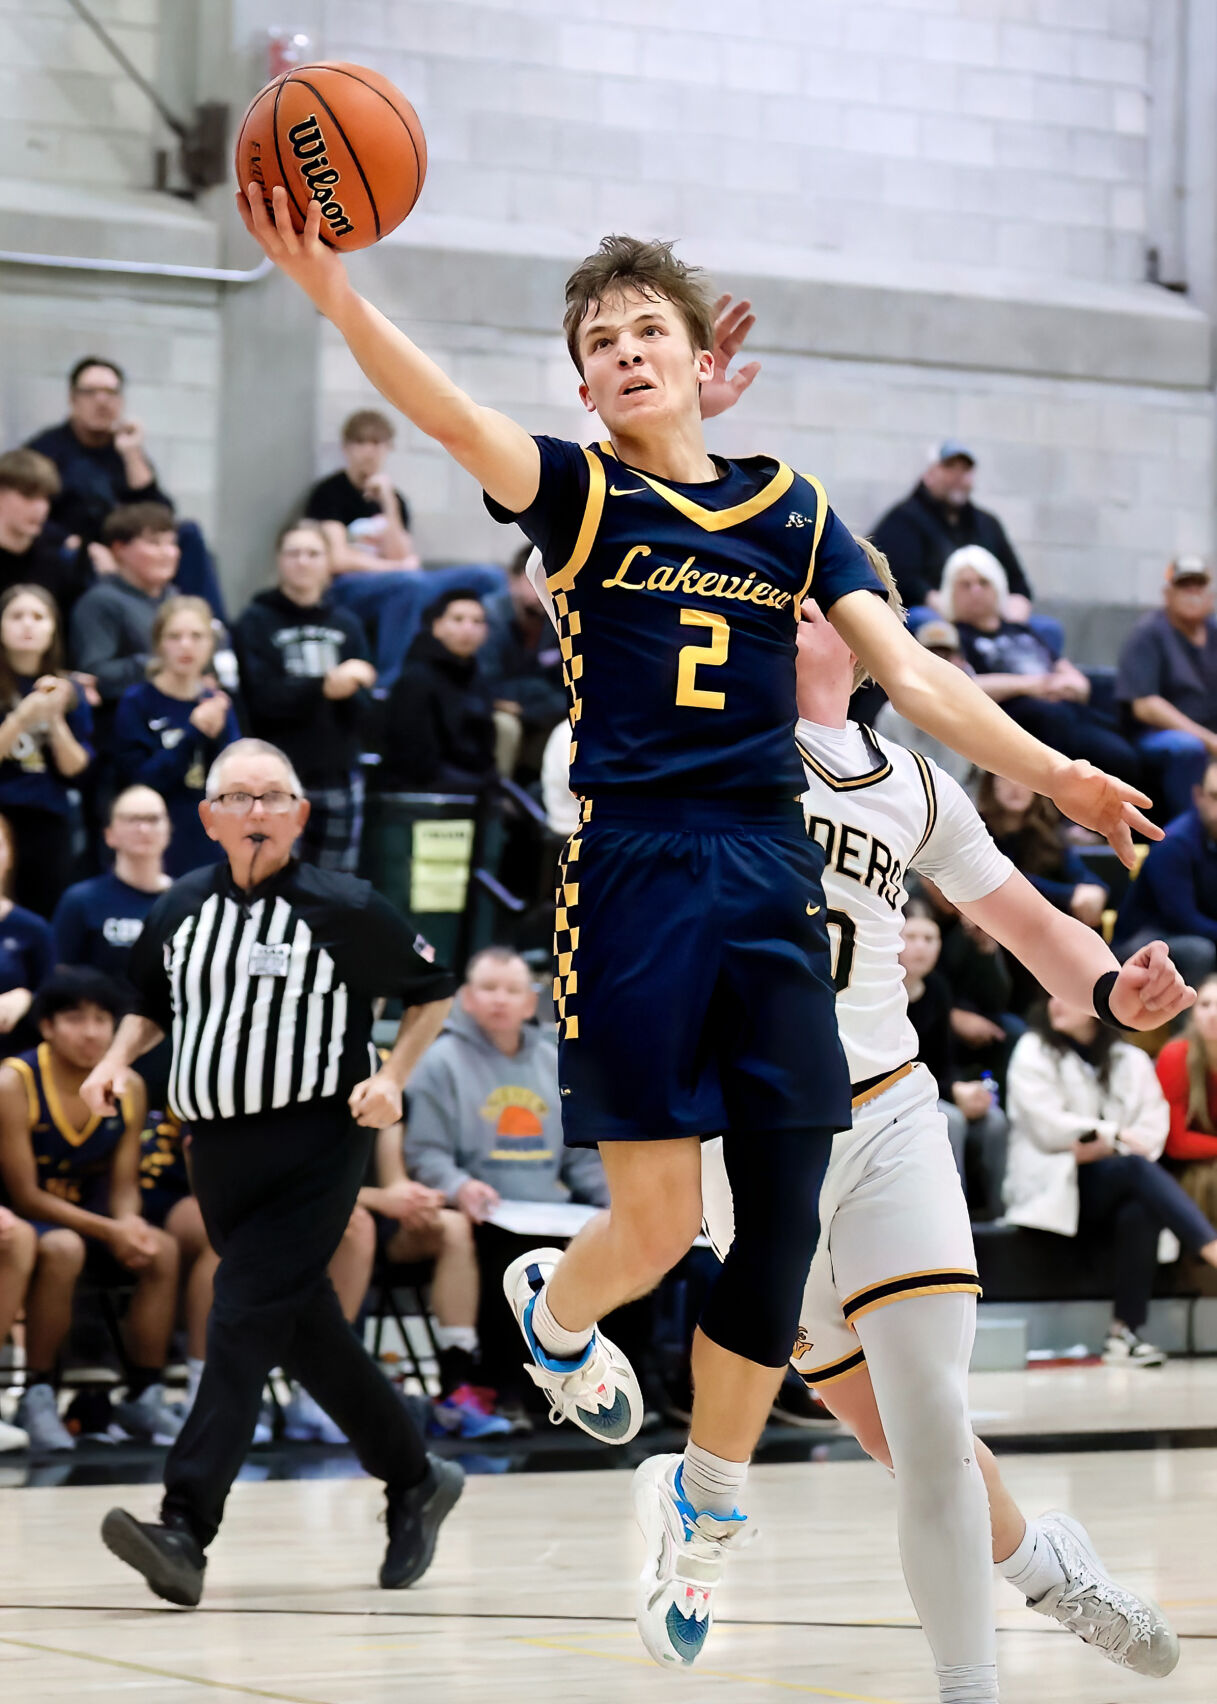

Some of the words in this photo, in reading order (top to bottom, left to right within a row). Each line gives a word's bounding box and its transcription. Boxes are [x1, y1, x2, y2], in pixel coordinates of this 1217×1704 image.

[287, 113, 355, 237] Wilson
[602, 545, 792, 610] Lakeview
[675, 608, 730, 710] 2
[808, 815, 901, 911] DERS
